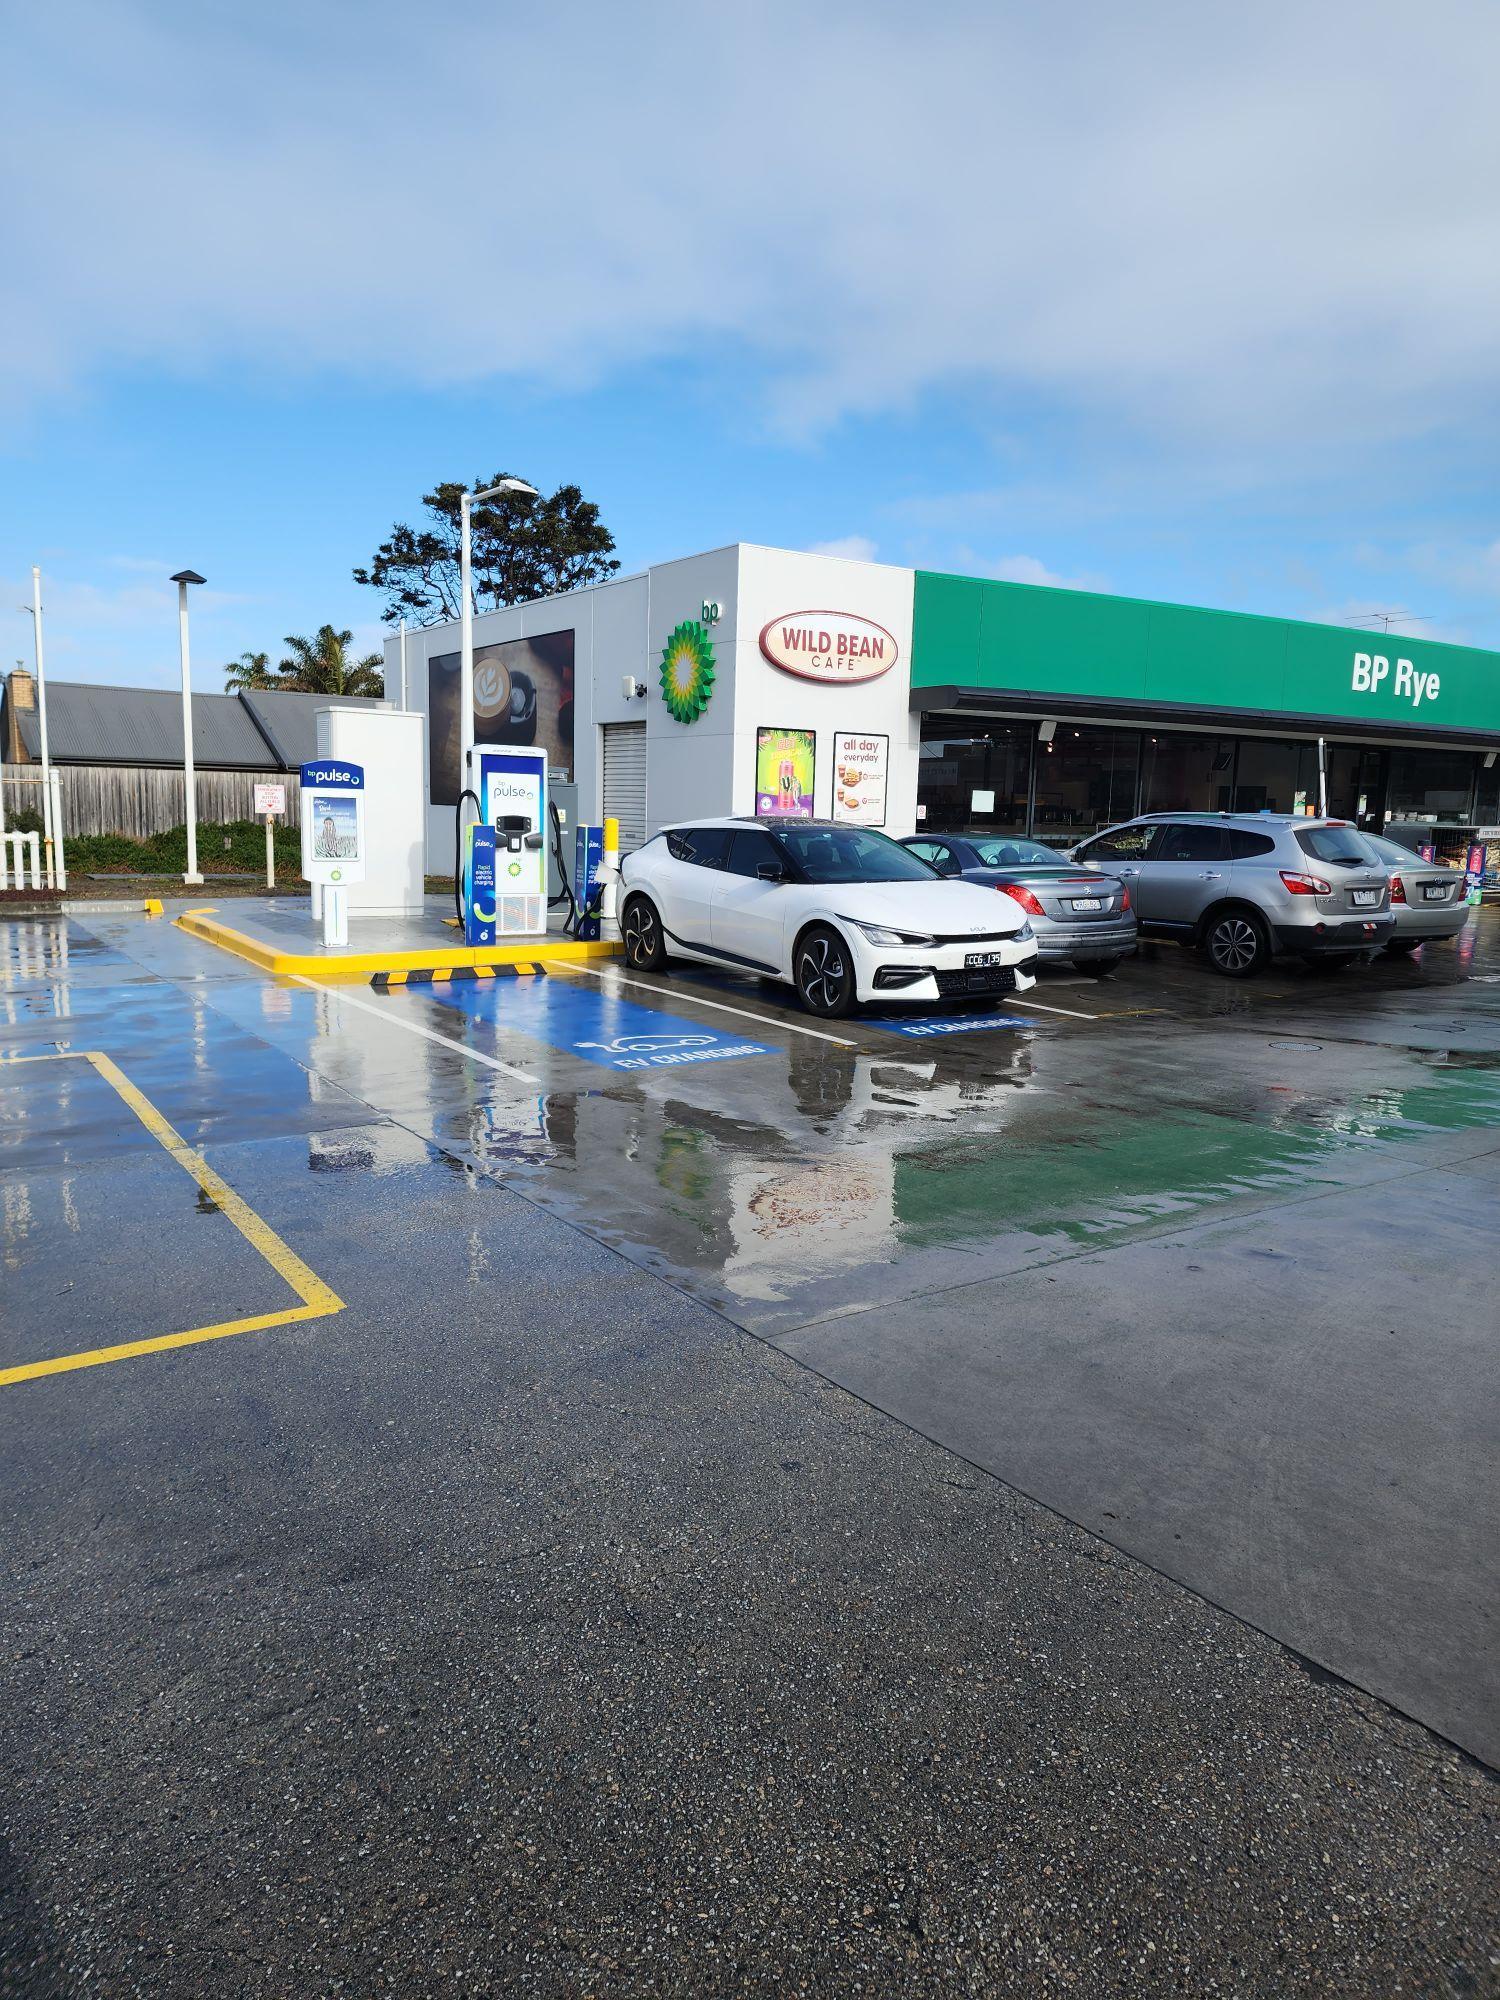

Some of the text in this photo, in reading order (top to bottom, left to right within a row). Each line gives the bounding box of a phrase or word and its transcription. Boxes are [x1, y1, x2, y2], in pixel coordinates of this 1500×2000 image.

[701, 600, 718, 624] bp
[782, 627, 884, 658] WILD BEAN
[1352, 652, 1440, 707] BP Rye
[843, 739, 879, 753] all day
[843, 753, 878, 763] everyday
[316, 768, 350, 784] pulse
[494, 785, 526, 799] pulse
[968, 955, 983, 965] CCG
[987, 954, 1000, 963] 135
[902, 1026, 935, 1036] EV
[614, 1045, 767, 1069] EV CHARGING
